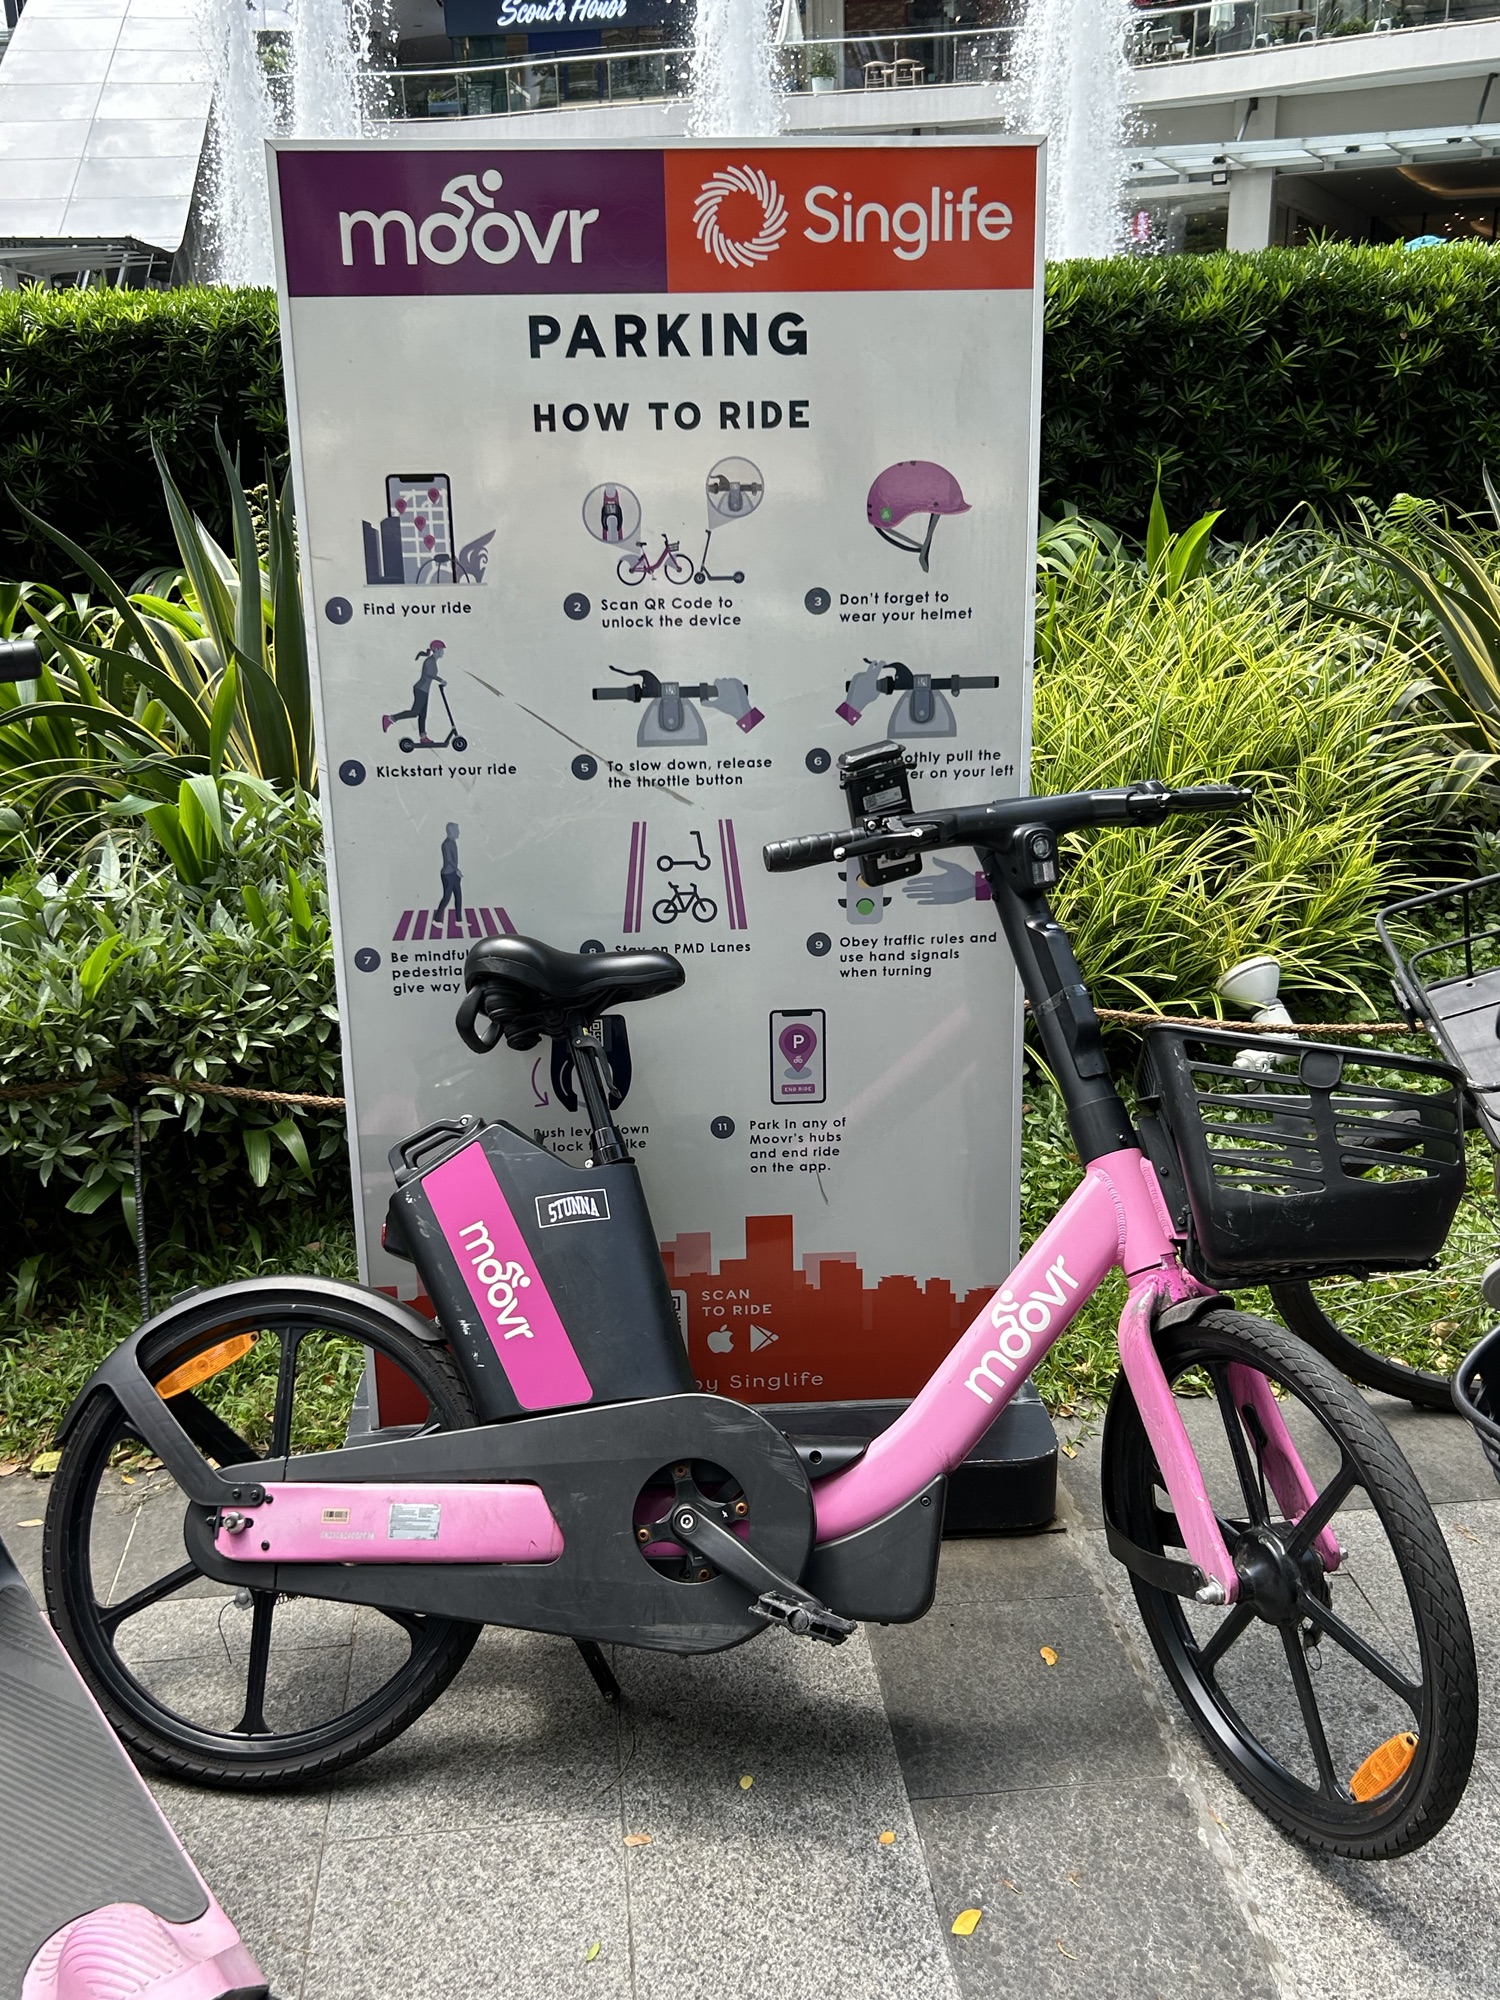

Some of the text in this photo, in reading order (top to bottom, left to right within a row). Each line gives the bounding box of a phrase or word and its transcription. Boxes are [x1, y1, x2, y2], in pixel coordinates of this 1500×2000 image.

[497, 0, 628, 26] Scout's Honor
[803, 186, 1013, 260] Singlife
[339, 197, 600, 267] moovr
[528, 312, 808, 358] PARKING
[533, 400, 810, 432] HOW TO RIDE
[601, 597, 733, 610] Scan QR Code to
[814, 597, 822, 606] 3
[839, 591, 949, 606] Don't forget to
[336, 607, 342, 615] 1
[363, 602, 472, 617] Find your ride
[573, 602, 582, 611] 2
[601, 614, 742, 628] unlock the device
[839, 608, 973, 624] wear your helmet
[813, 757, 823, 765] 6
[901, 750, 1001, 765] othly pull the
[376, 763, 517, 778] Kickstart your ride
[580, 764, 589, 772] 5
[607, 758, 773, 772] To slow down, release
[348, 769, 357, 777] 4
[929, 770, 948, 778] on
[953, 769, 986, 780] your
[990, 765, 1014, 776] left
[608, 774, 743, 788] the throttle button
[815, 941, 824, 949] 9
[839, 932, 997, 948] Obey traffic rules and
[615, 945, 645, 953] Sta
[674, 943, 705, 954] PMD
[710, 943, 751, 952] Lanes
[839, 949, 960, 962] use hand signals
[390, 953, 409, 962] Be
[392, 966, 462, 980] pedestria
[839, 965, 932, 977] when turning
[393, 983, 461, 996] give way
[793, 1035, 805, 1048] P
[571, 1127, 592, 1137] lev
[619, 1124, 650, 1136] own
[749, 1117, 847, 1130] Park in any of
[553, 1141, 584, 1152] lock
[626, 1138, 647, 1150] ike
[749, 1132, 842, 1144] Moovr's hubs
[749, 1147, 840, 1158] and end ride
[772, 1163, 795, 1172] the
[799, 1161, 832, 1175] app.
[548, 1196, 600, 1223] STUNNA
[459, 1220, 535, 1341] moovr
[701, 1289, 750, 1300] SCAN
[701, 1304, 772, 1316] TO RIDE
[963, 1254, 1080, 1405] moovr
[729, 1372, 824, 1390] Singlife
